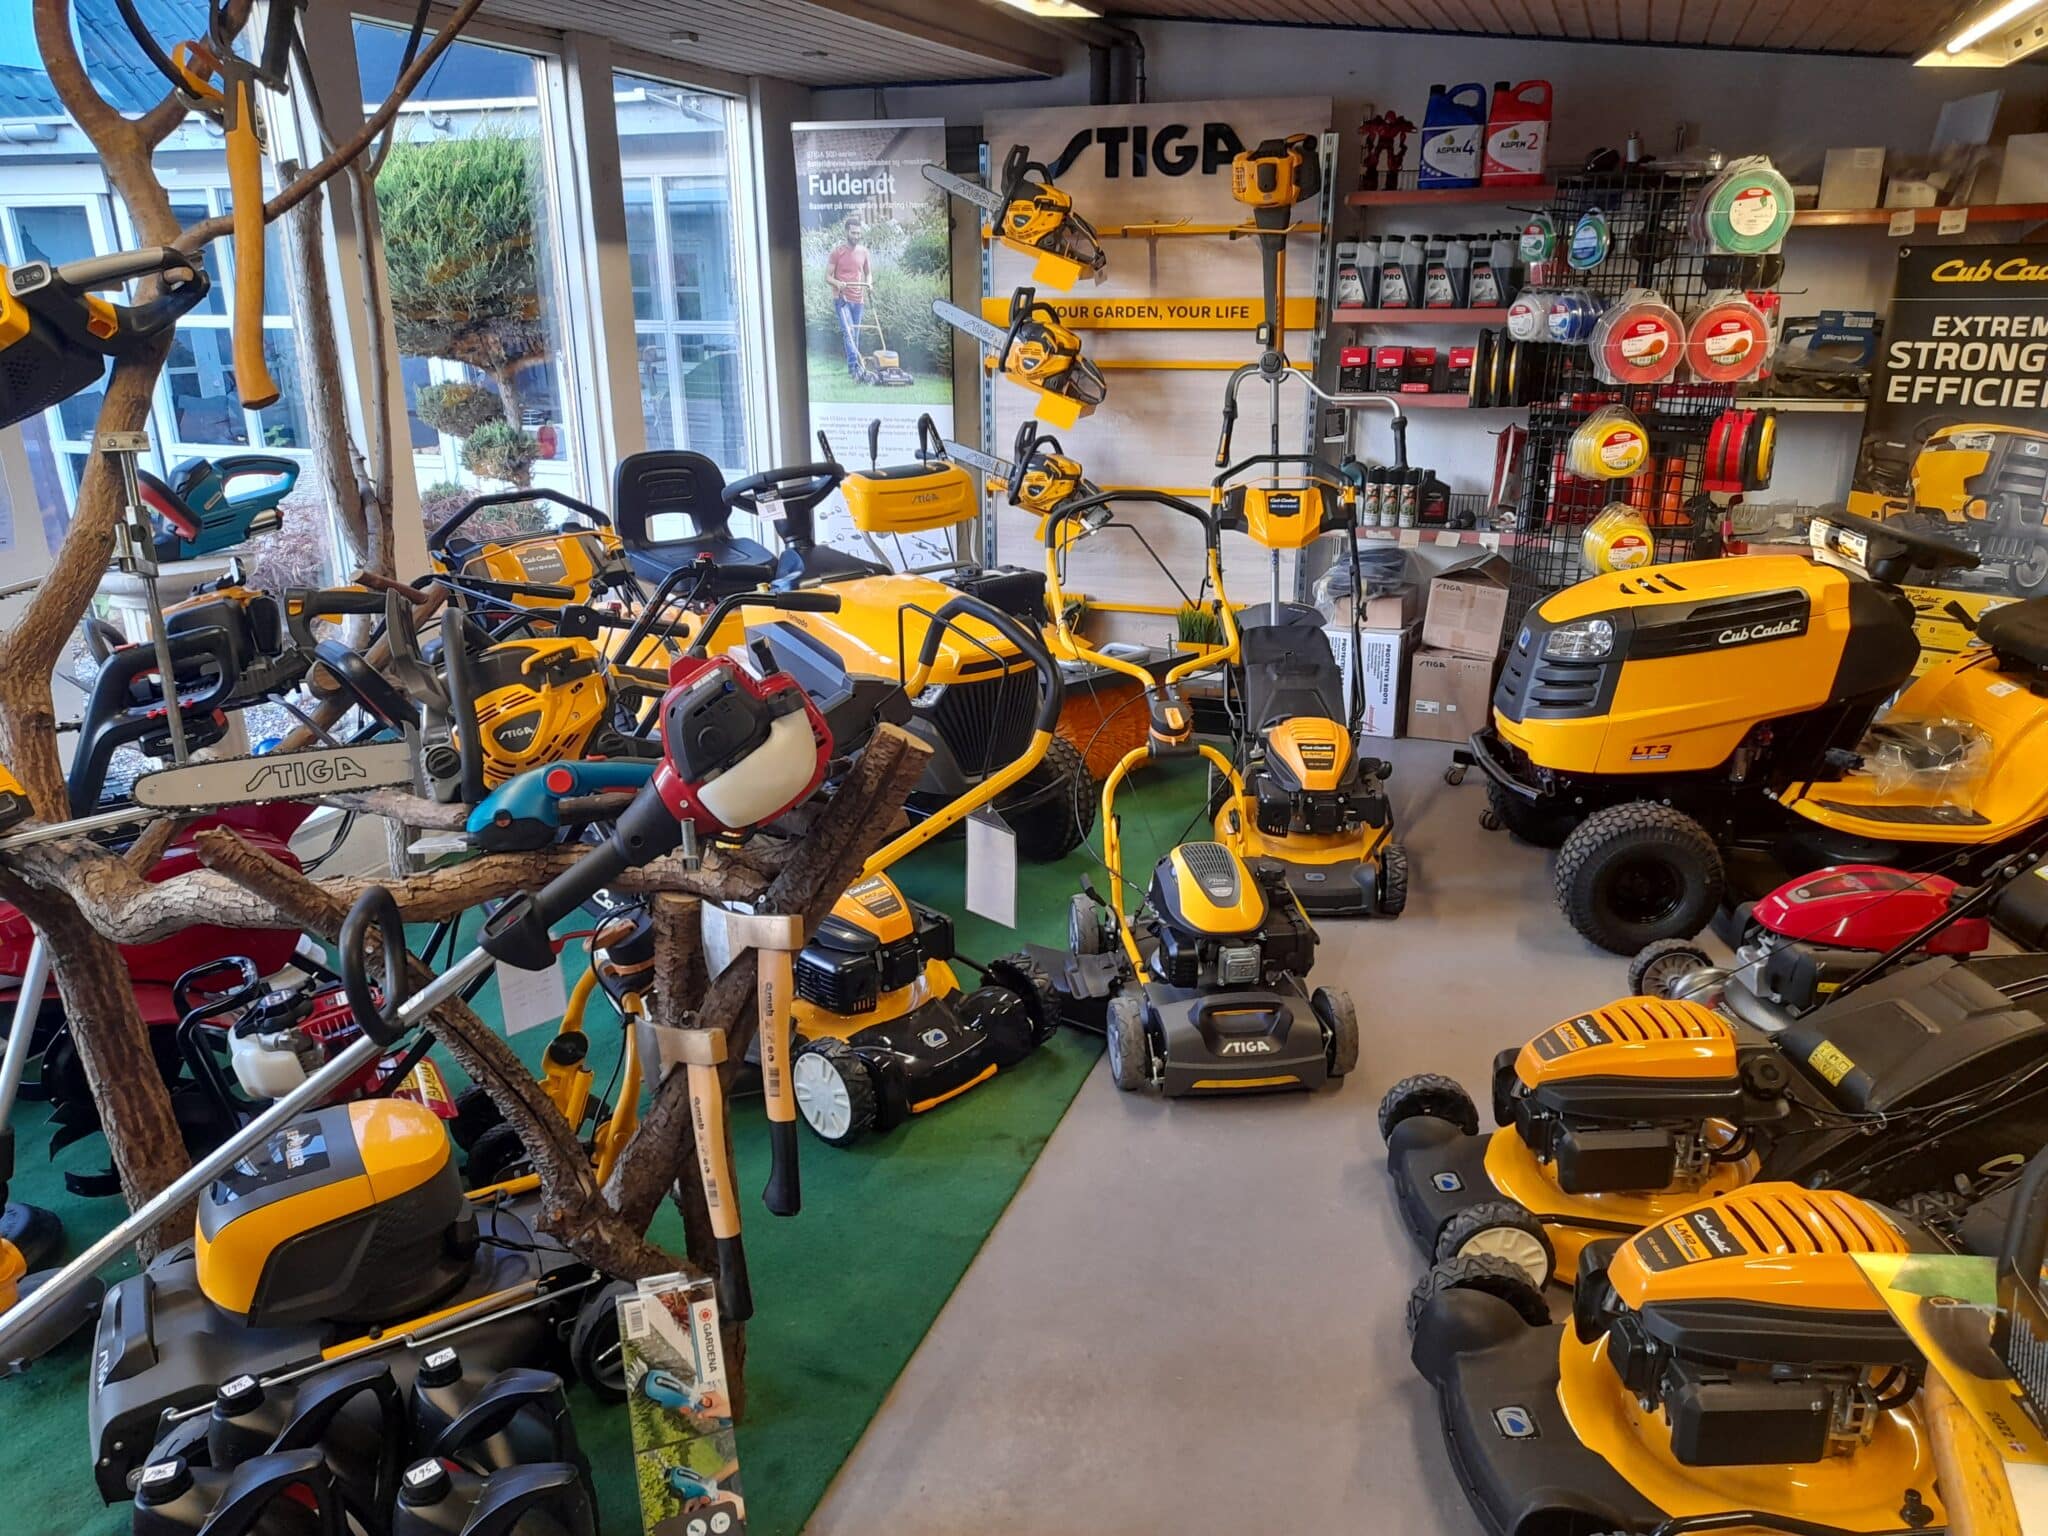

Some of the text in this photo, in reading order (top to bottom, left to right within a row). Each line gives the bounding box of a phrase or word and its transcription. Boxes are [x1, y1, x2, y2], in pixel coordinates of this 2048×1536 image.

[1048, 122, 1246, 179] STIGA
[1436, 139, 1475, 156] ASPEN 4
[1500, 133, 1538, 150] ASPEN 2
[808, 172, 897, 197] Fuldendt
[953, 182, 991, 206] STIGA
[1472, 273, 1491, 281] PRO
[1931, 258, 1993, 283] Cub
[1094, 305, 1163, 321] GARDEN,
[1168, 305, 1211, 319] YOUR
[1216, 304, 1250, 318] LIFE
[1886, 340, 2048, 373] STRONG
[536, 553, 557, 562] Cadet
[1435, 583, 1463, 592] STIGA
[1718, 618, 1801, 645] Cub Cadet
[543, 652, 564, 666] Start
[1384, 643, 1392, 682] PROTECTIVE
[1418, 660, 1447, 669] STIGA
[498, 726, 535, 741] STIGA
[1631, 744, 1673, 755] LT3
[245, 755, 367, 793] STIGA
[1577, 1018, 1602, 1044] Cub Cadet
[1222, 1040, 1271, 1055] STIGA
[1674, 1223, 1697, 1246] LM2
[1694, 1213, 1732, 1254] Cub Cadet
[703, 1322, 718, 1374] GARDENA
[1985, 1409, 2017, 1439] 2022
